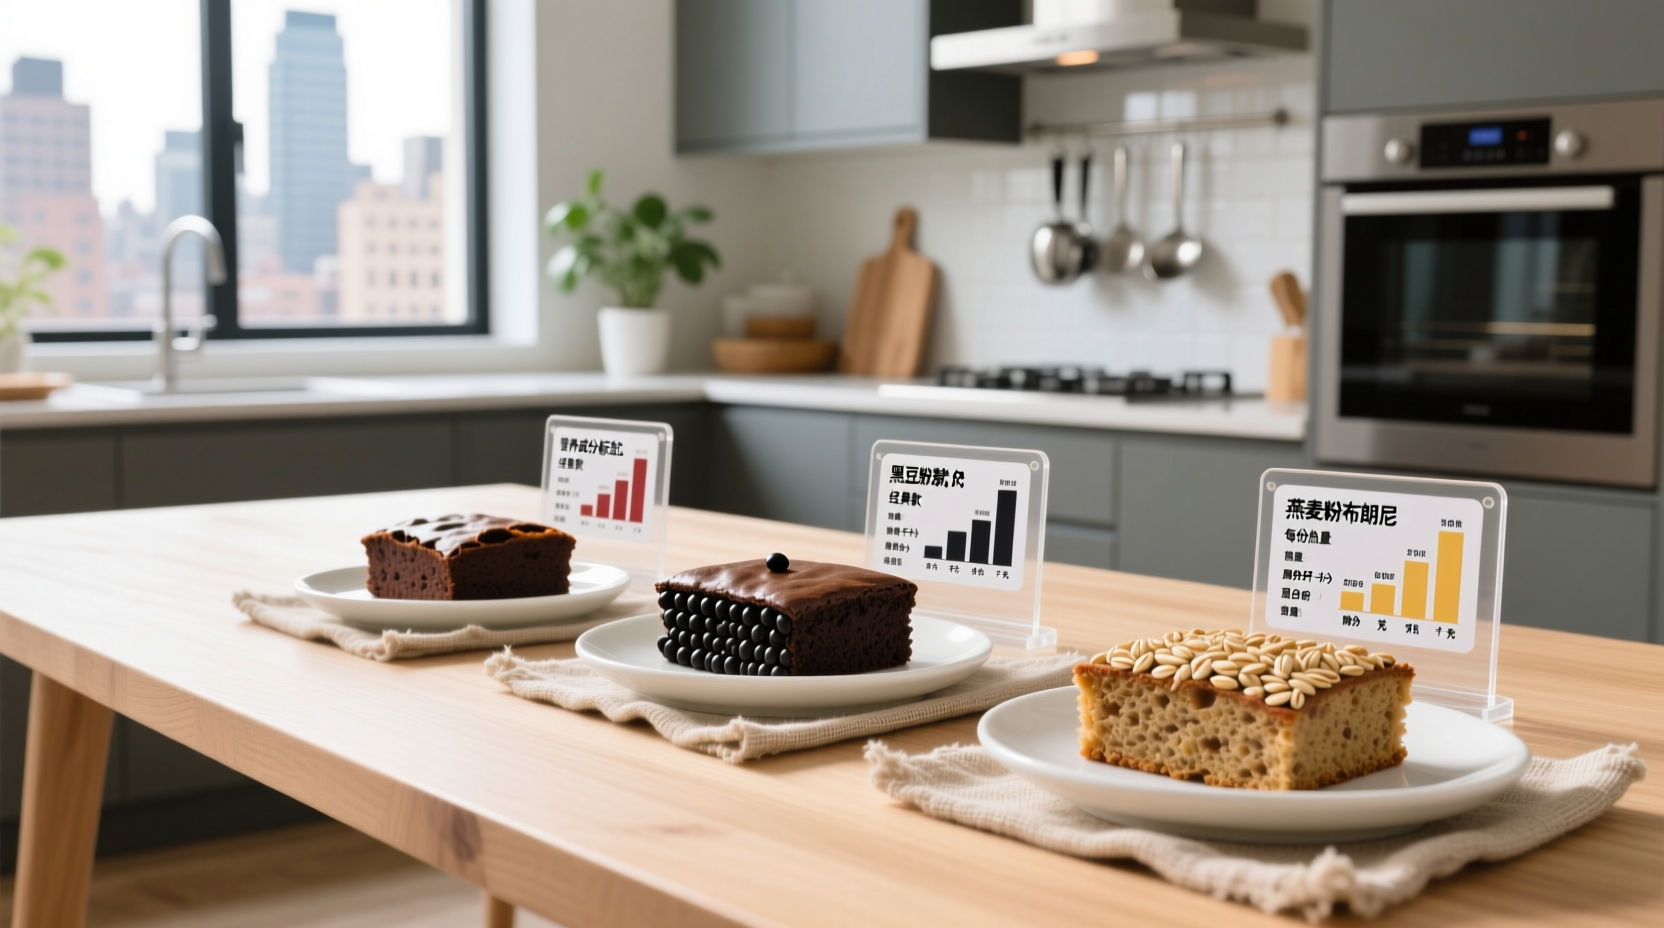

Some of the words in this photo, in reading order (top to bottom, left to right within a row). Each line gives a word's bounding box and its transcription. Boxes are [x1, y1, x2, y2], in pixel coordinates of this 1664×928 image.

[1285, 498, 1397, 526] 燕麦粉布朗尼
